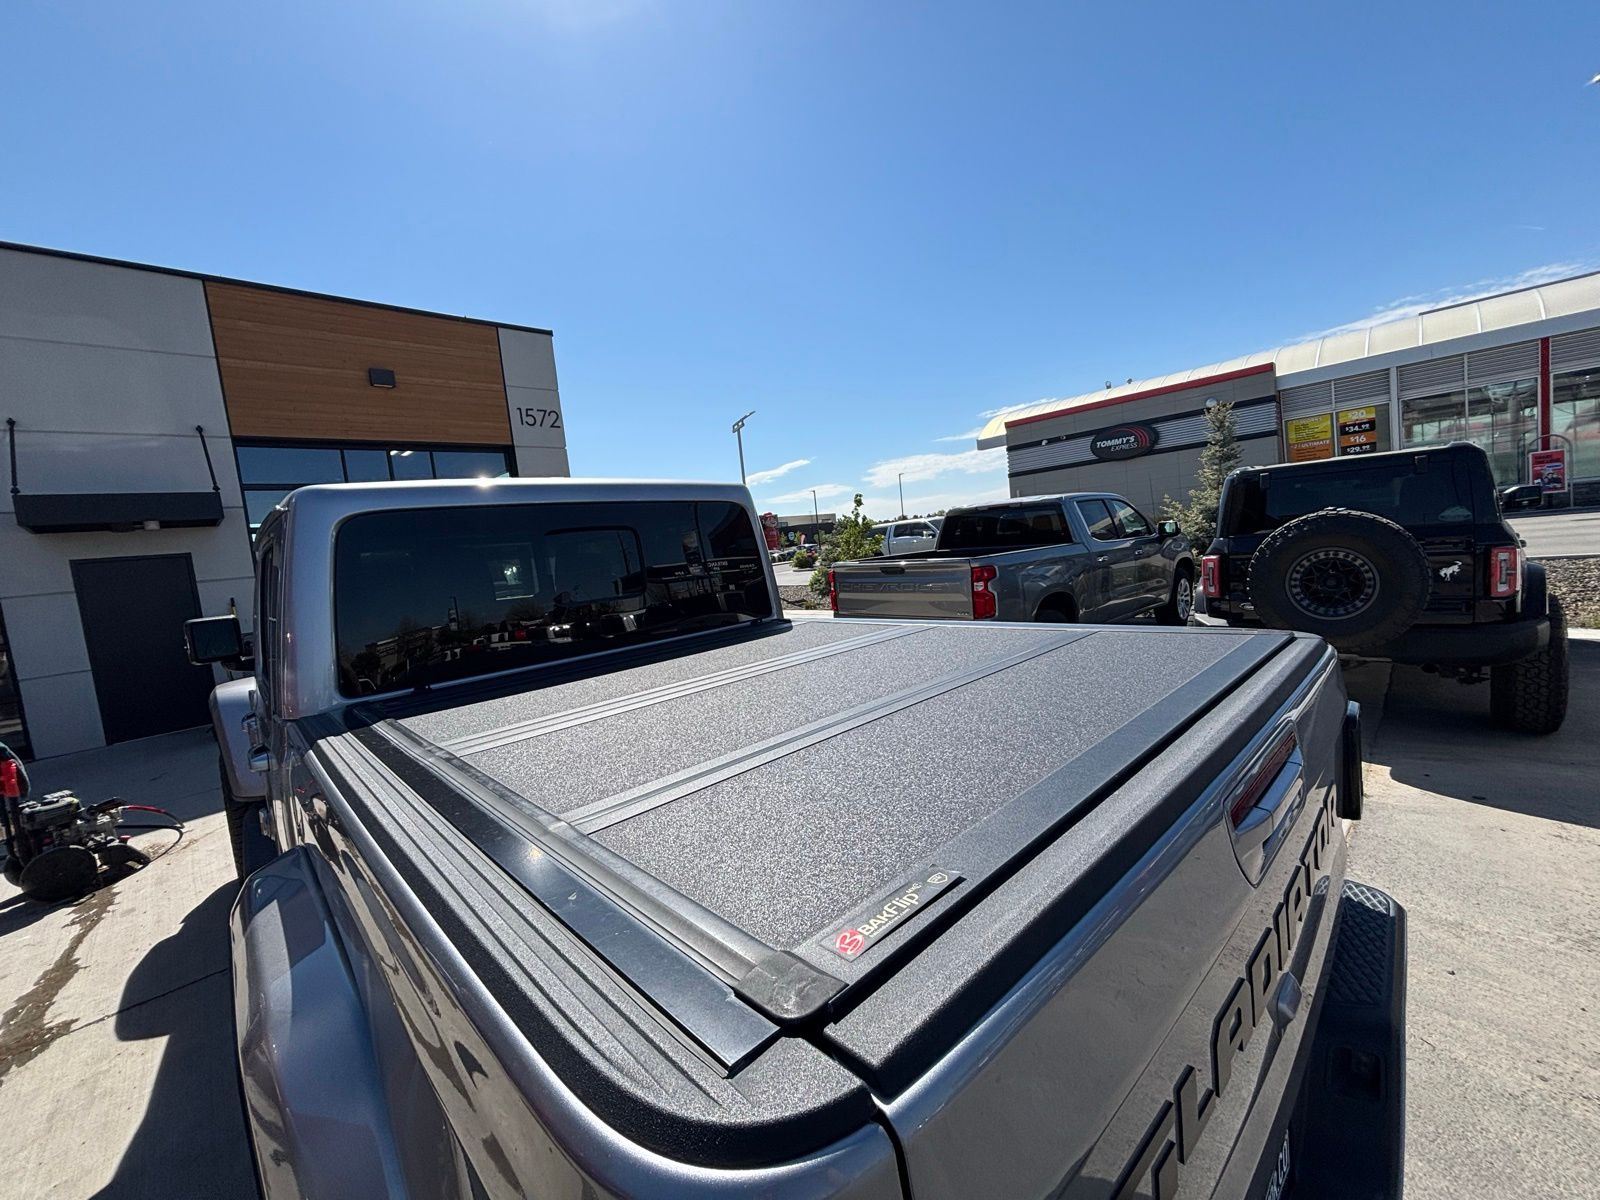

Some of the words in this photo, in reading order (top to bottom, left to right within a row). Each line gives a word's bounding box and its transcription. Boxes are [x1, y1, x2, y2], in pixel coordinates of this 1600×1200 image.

[516, 407, 561, 428] 1572
[1096, 435, 1135, 449] TOMMY'S
[1111, 442, 1138, 452] EXPRESS
